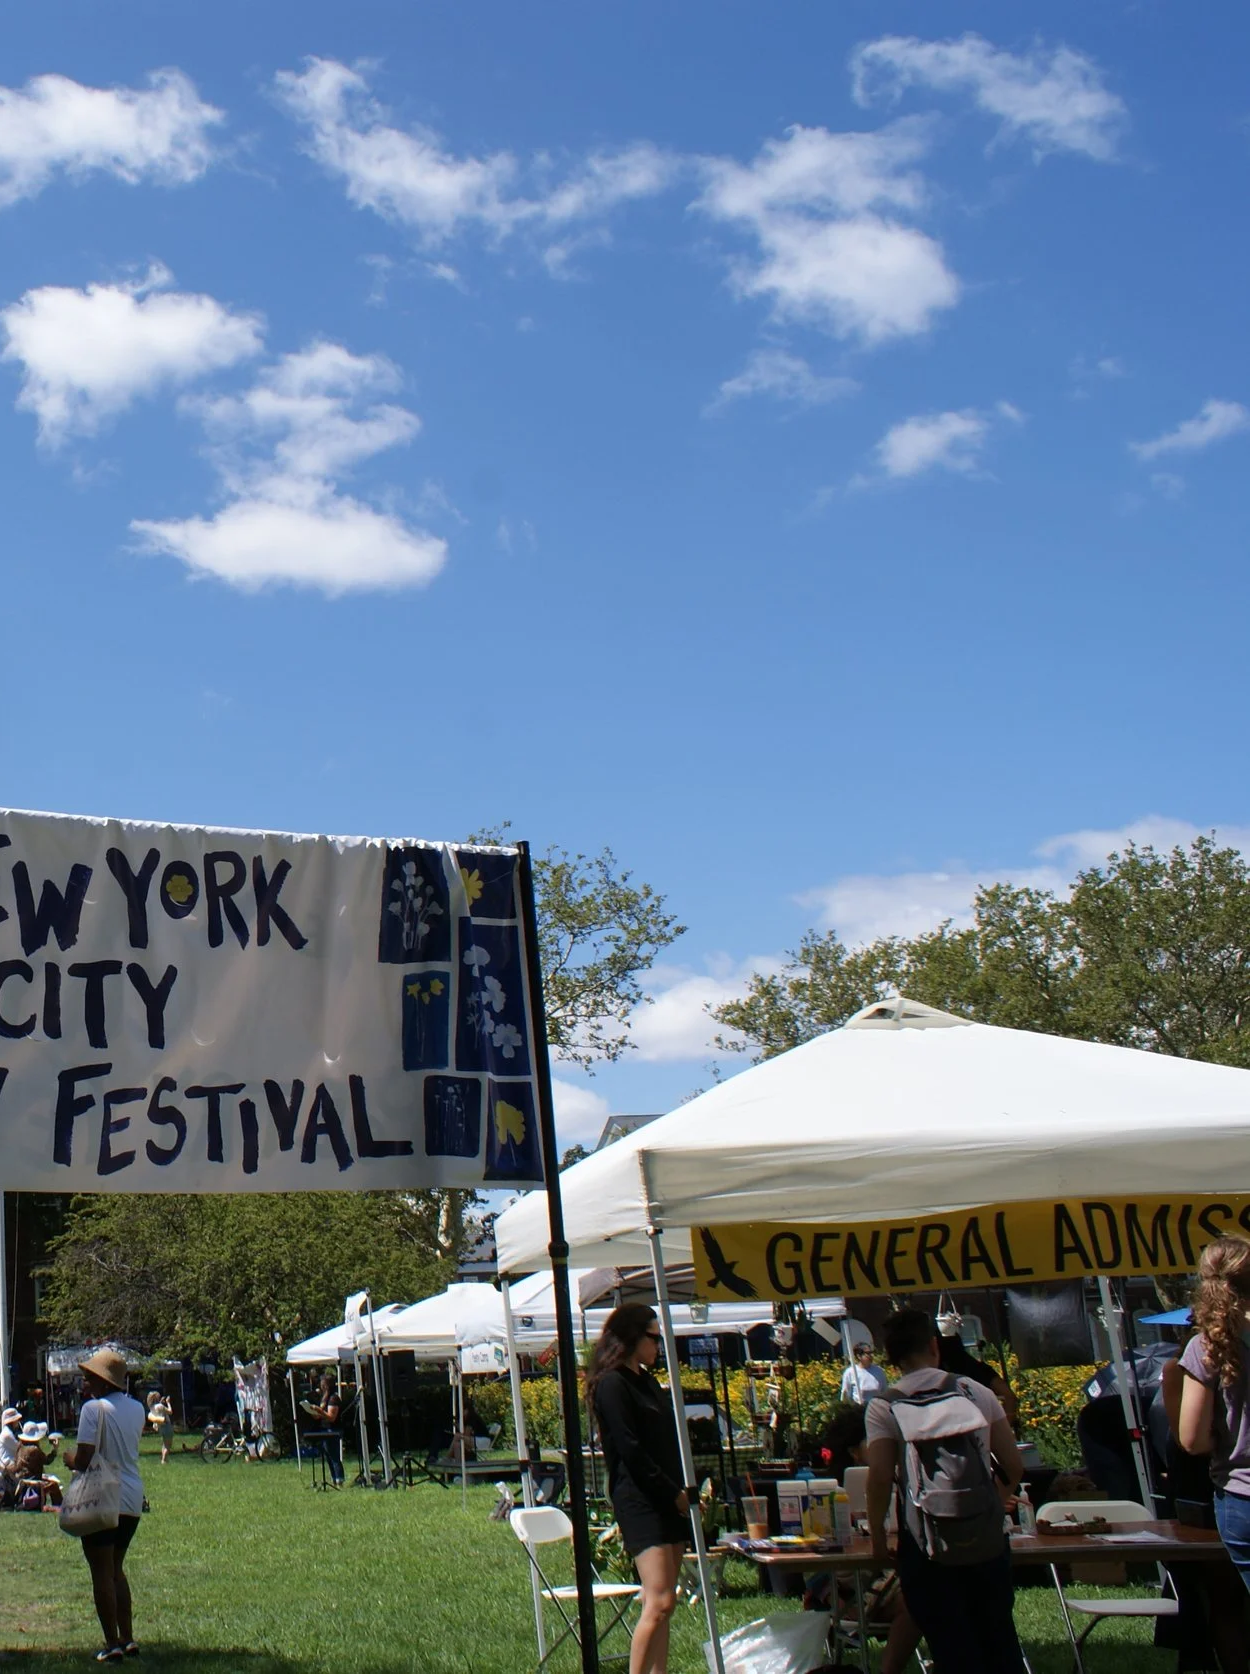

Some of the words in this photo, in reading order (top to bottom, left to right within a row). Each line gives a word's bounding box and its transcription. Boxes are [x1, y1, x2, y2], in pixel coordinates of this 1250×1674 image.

[105, 847, 308, 950] YORK
[52, 1062, 414, 1176] FESTIVAL
[765, 1211, 1034, 1295] GENERAL
[1053, 1201, 1250, 1272] ADMIS
